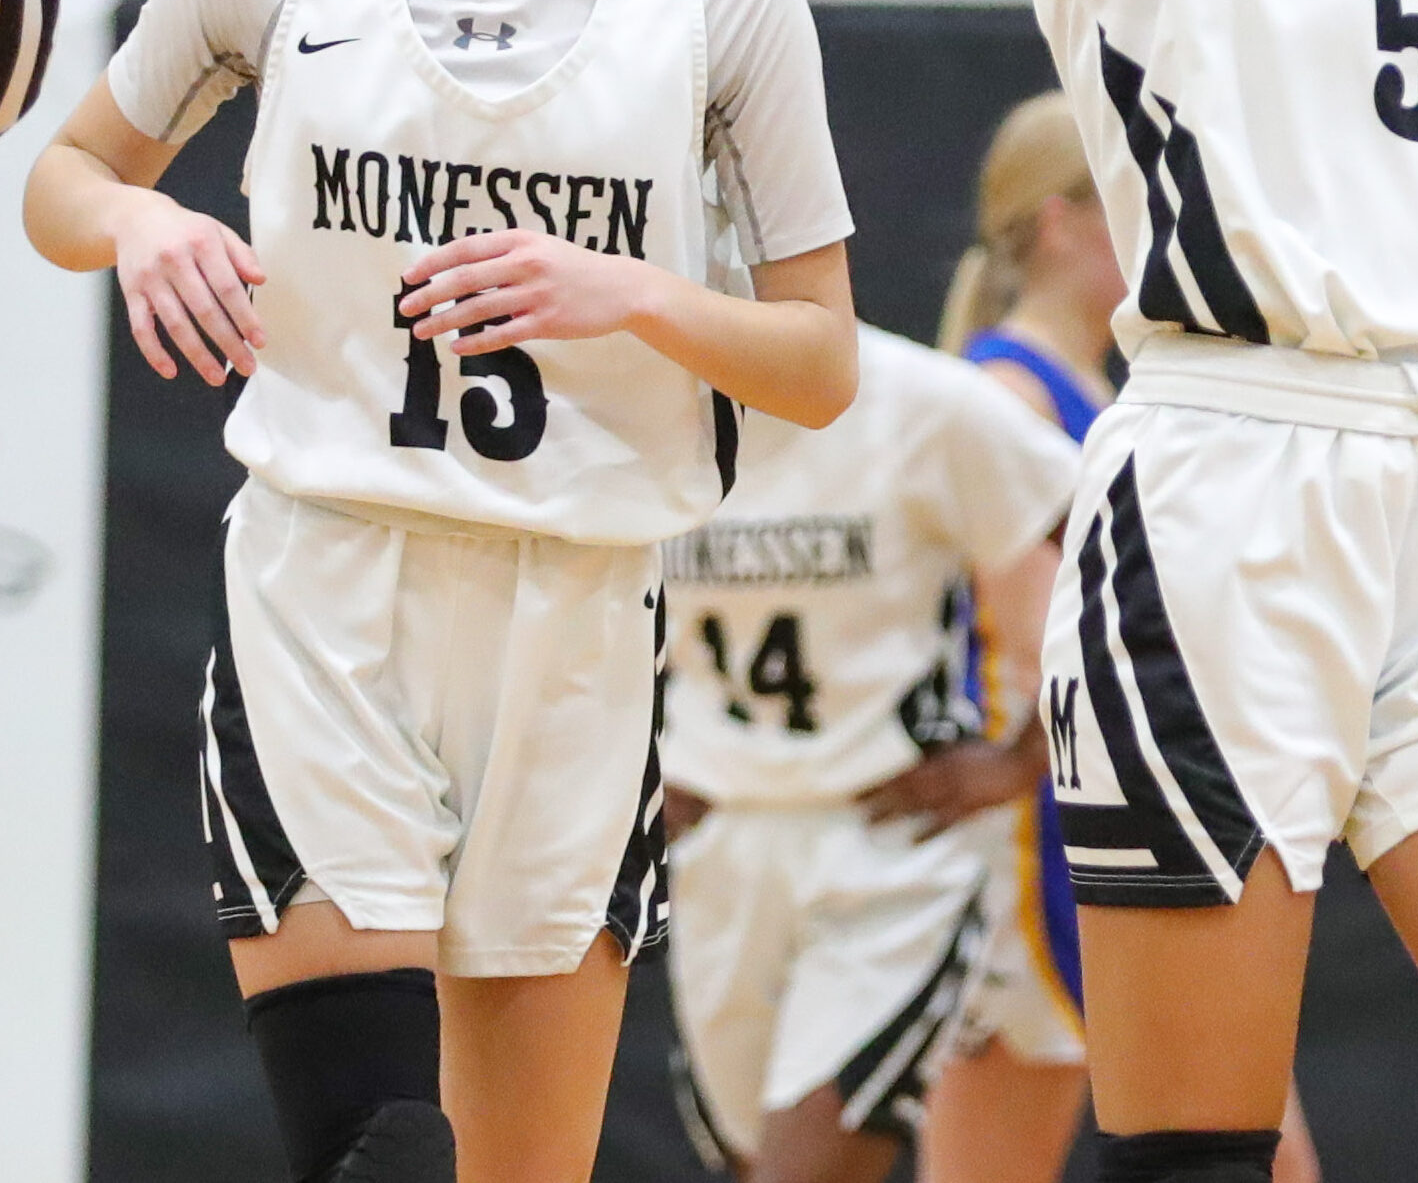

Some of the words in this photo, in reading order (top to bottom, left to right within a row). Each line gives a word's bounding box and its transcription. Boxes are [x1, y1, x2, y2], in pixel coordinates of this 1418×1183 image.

[311, 143, 654, 261] MONESSEN
[389, 275, 550, 463] 15
[699, 610, 820, 734] 14
[1050, 675, 1082, 792] M
